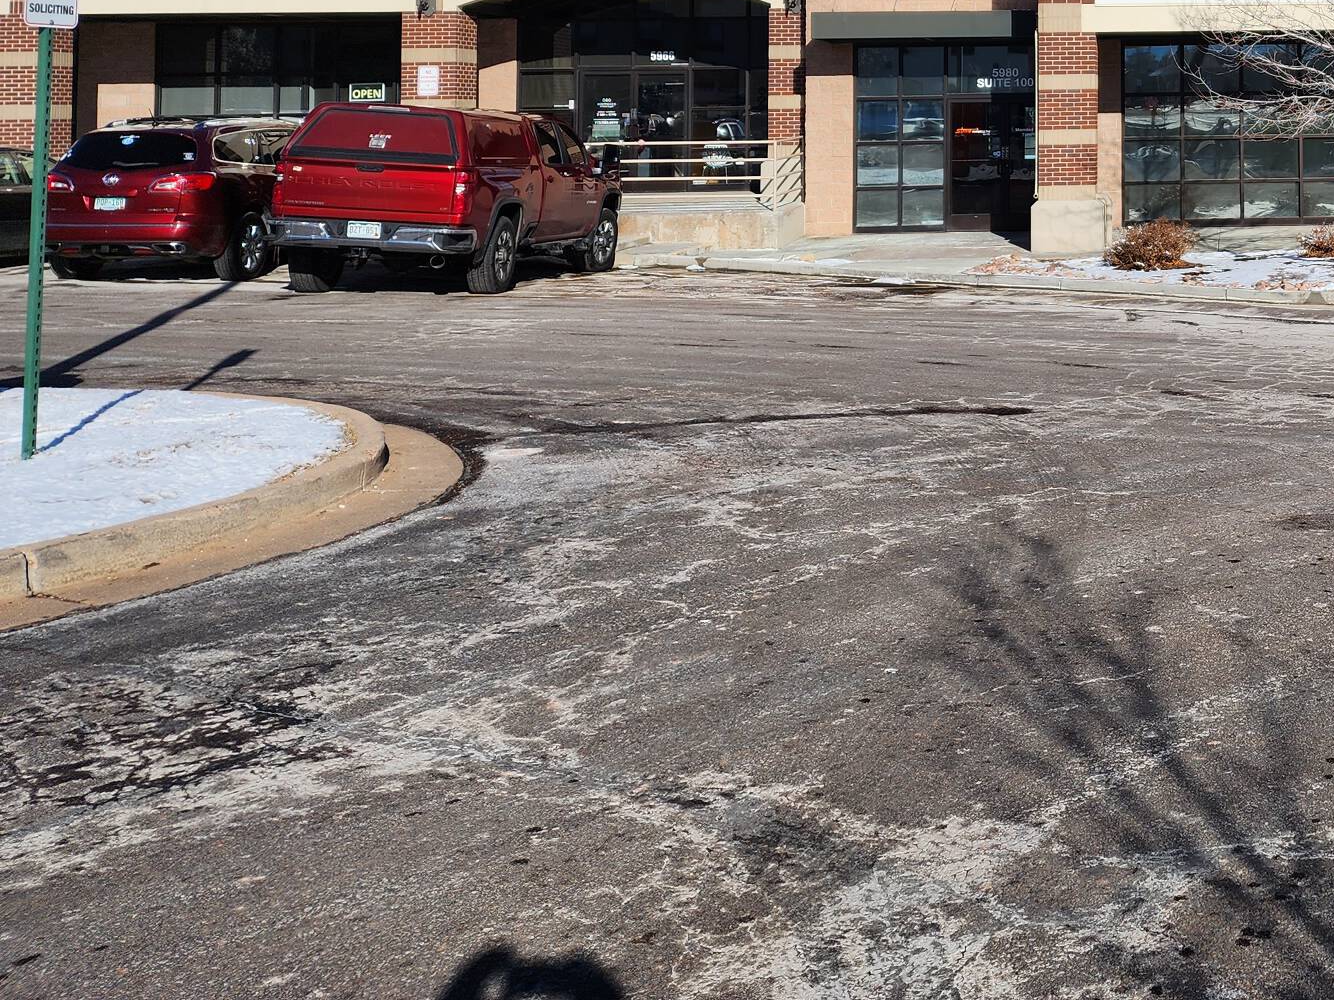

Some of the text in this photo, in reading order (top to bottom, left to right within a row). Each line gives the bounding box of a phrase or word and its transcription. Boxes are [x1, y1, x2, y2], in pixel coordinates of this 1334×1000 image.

[29, 2, 74, 15] SOLICITING
[650, 50, 675, 61] 5966
[992, 68, 1019, 77] 5980
[976, 77, 1034, 88] SUITE 100
[352, 89, 382, 99] OPEN
